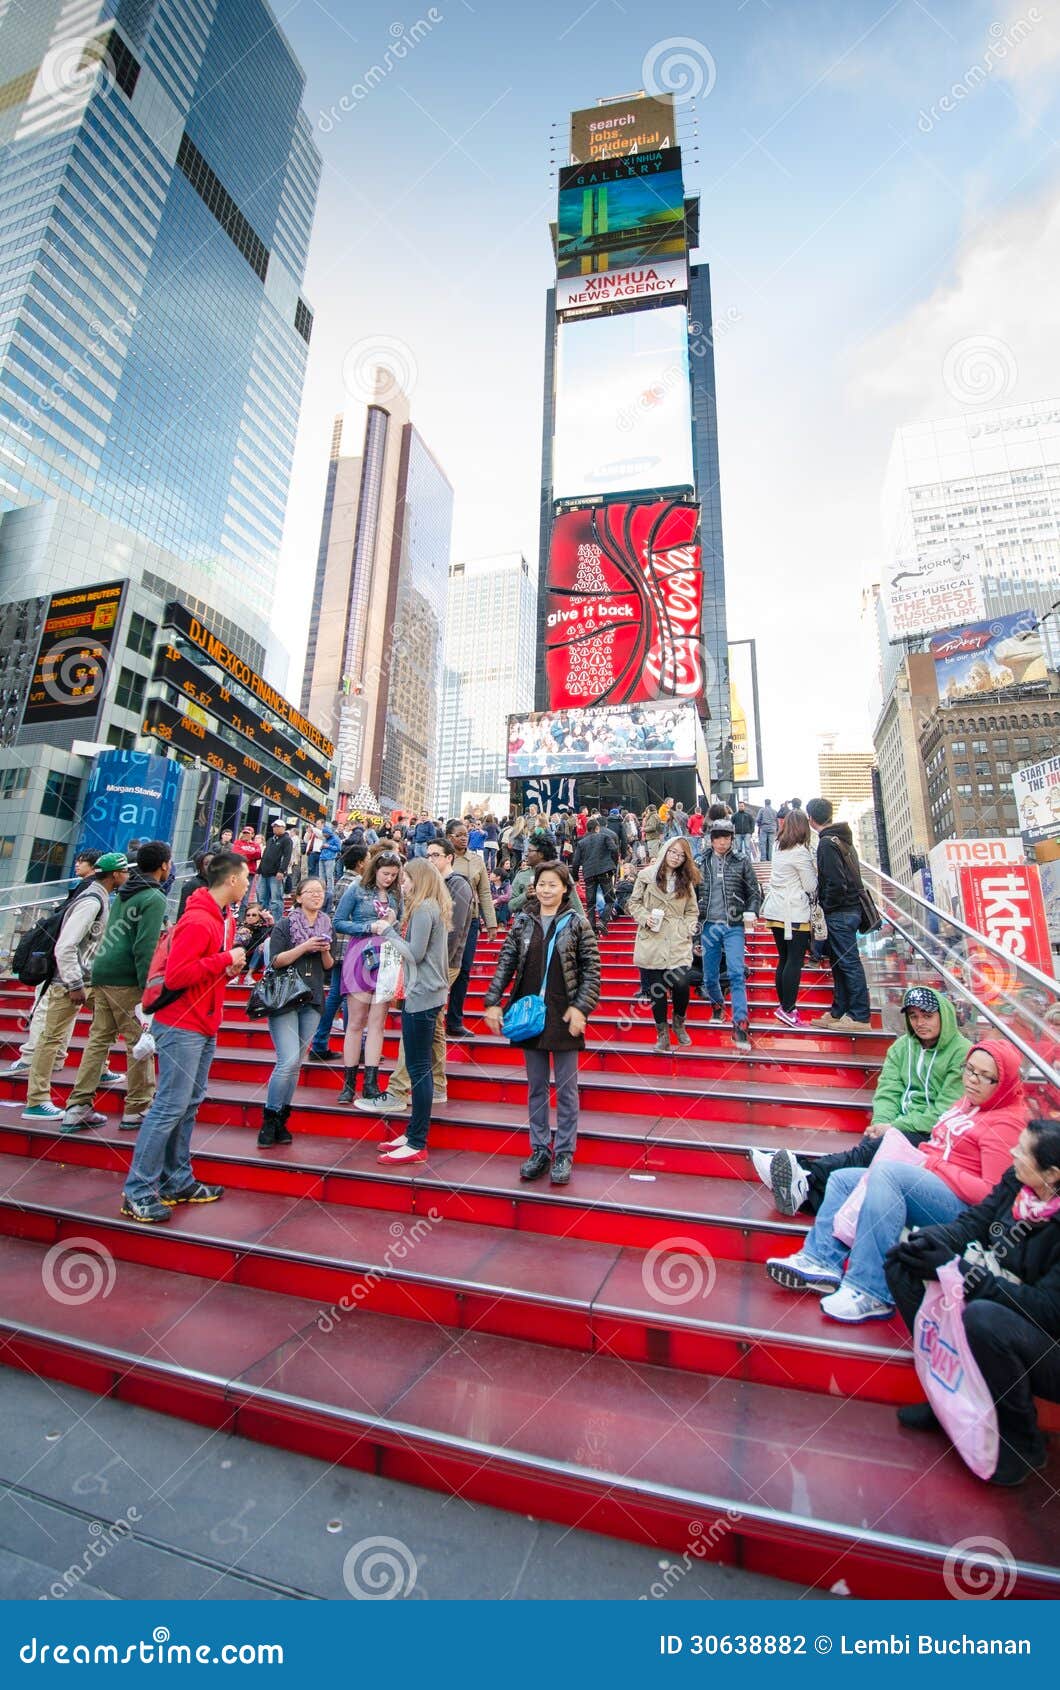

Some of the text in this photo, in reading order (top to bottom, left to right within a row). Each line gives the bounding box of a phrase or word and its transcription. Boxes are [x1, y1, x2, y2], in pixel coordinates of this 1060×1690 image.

[589, 114, 636, 131] search
[589, 129, 623, 145] jobs.
[590, 131, 660, 156] prudential
[623, 152, 662, 166] XINHUA
[577, 162, 662, 184] GALLERY
[568, 278, 676, 304] NEWS AGENCY
[585, 269, 658, 291] XINHUA
[891, 592, 918, 603] BEST
[922, 579, 975, 596] MUSICAL
[893, 587, 975, 614] THE BEST
[547, 604, 633, 626] give it back
[894, 598, 977, 624] MUSICAL OF
[895, 606, 977, 630] THIS CENTURY
[189, 619, 207, 648] DJ
[207, 635, 250, 684] MEXICO
[251, 676, 288, 719] FINANCE
[945, 656, 955, 664] be
[1020, 763, 1046, 782] START
[1028, 777, 1045, 792] THE
[945, 841, 1007, 860] men
[981, 873, 1032, 958] tkts
